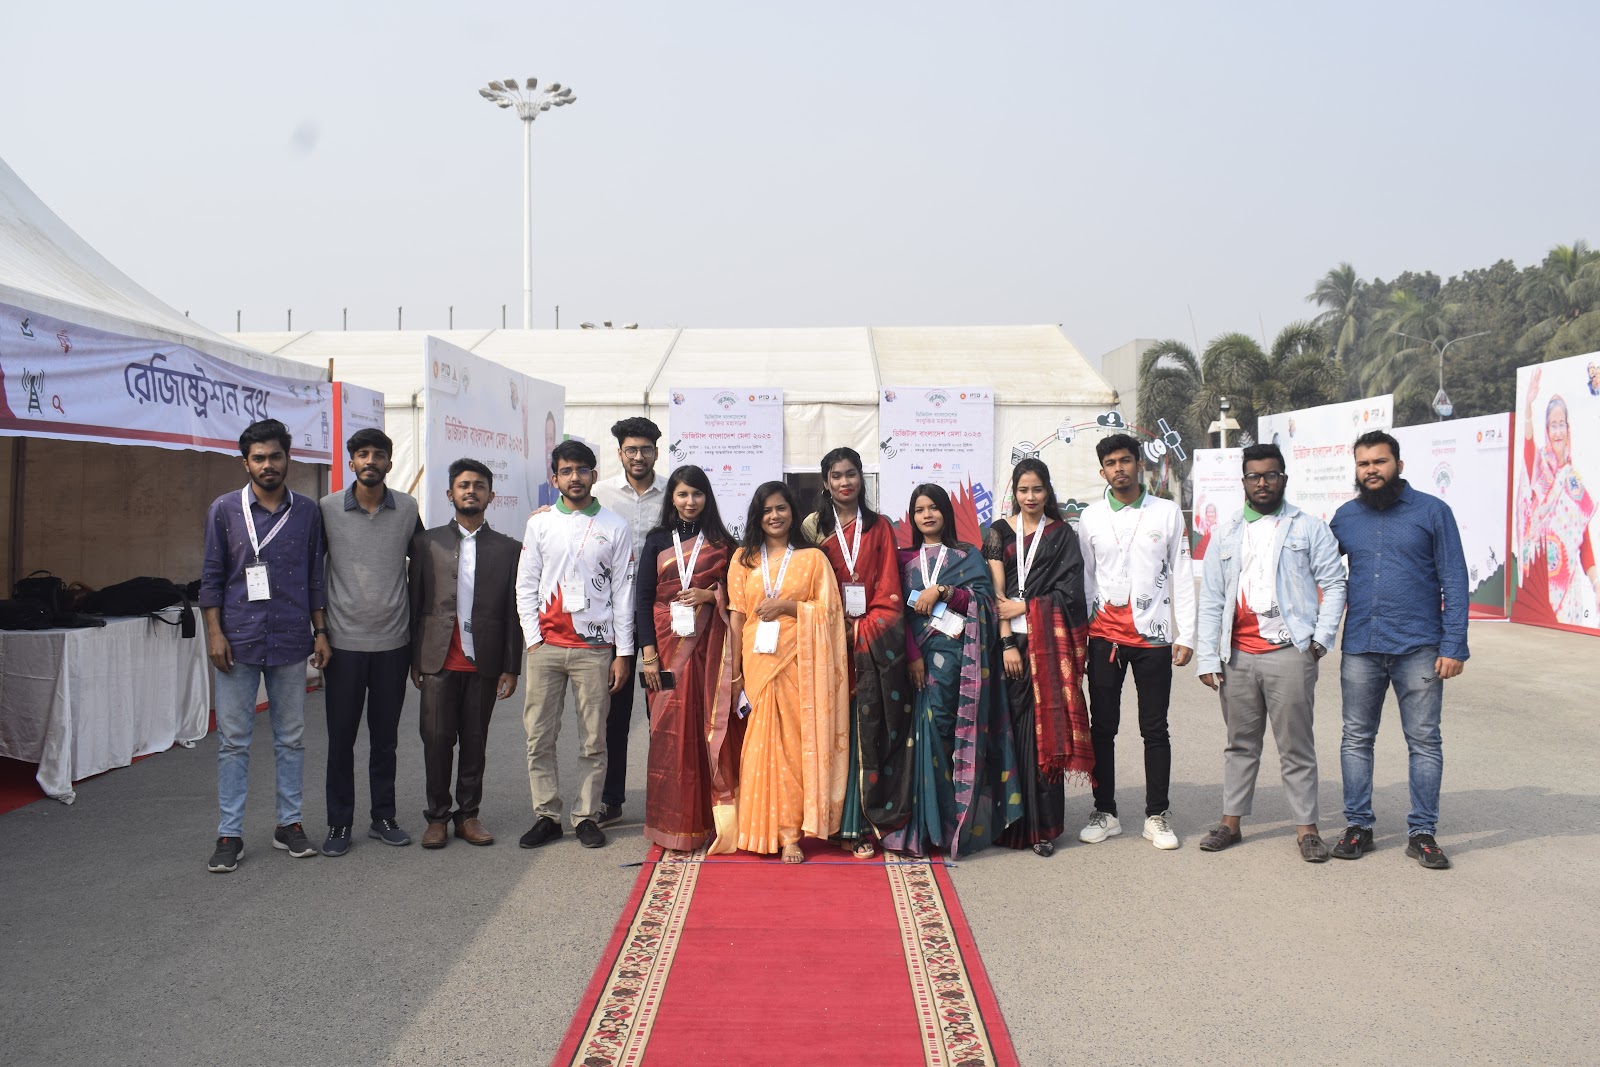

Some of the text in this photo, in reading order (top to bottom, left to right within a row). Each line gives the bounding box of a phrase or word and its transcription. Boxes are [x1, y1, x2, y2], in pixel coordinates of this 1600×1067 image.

[241, 385, 270, 423] বথ
[444, 415, 522, 454] ডিজিটাল বাংলাদেশ মেলা ২০২৩
[682, 432, 706, 440] ডিজিটাল
[892, 429, 917, 437] ডিজিটাল
